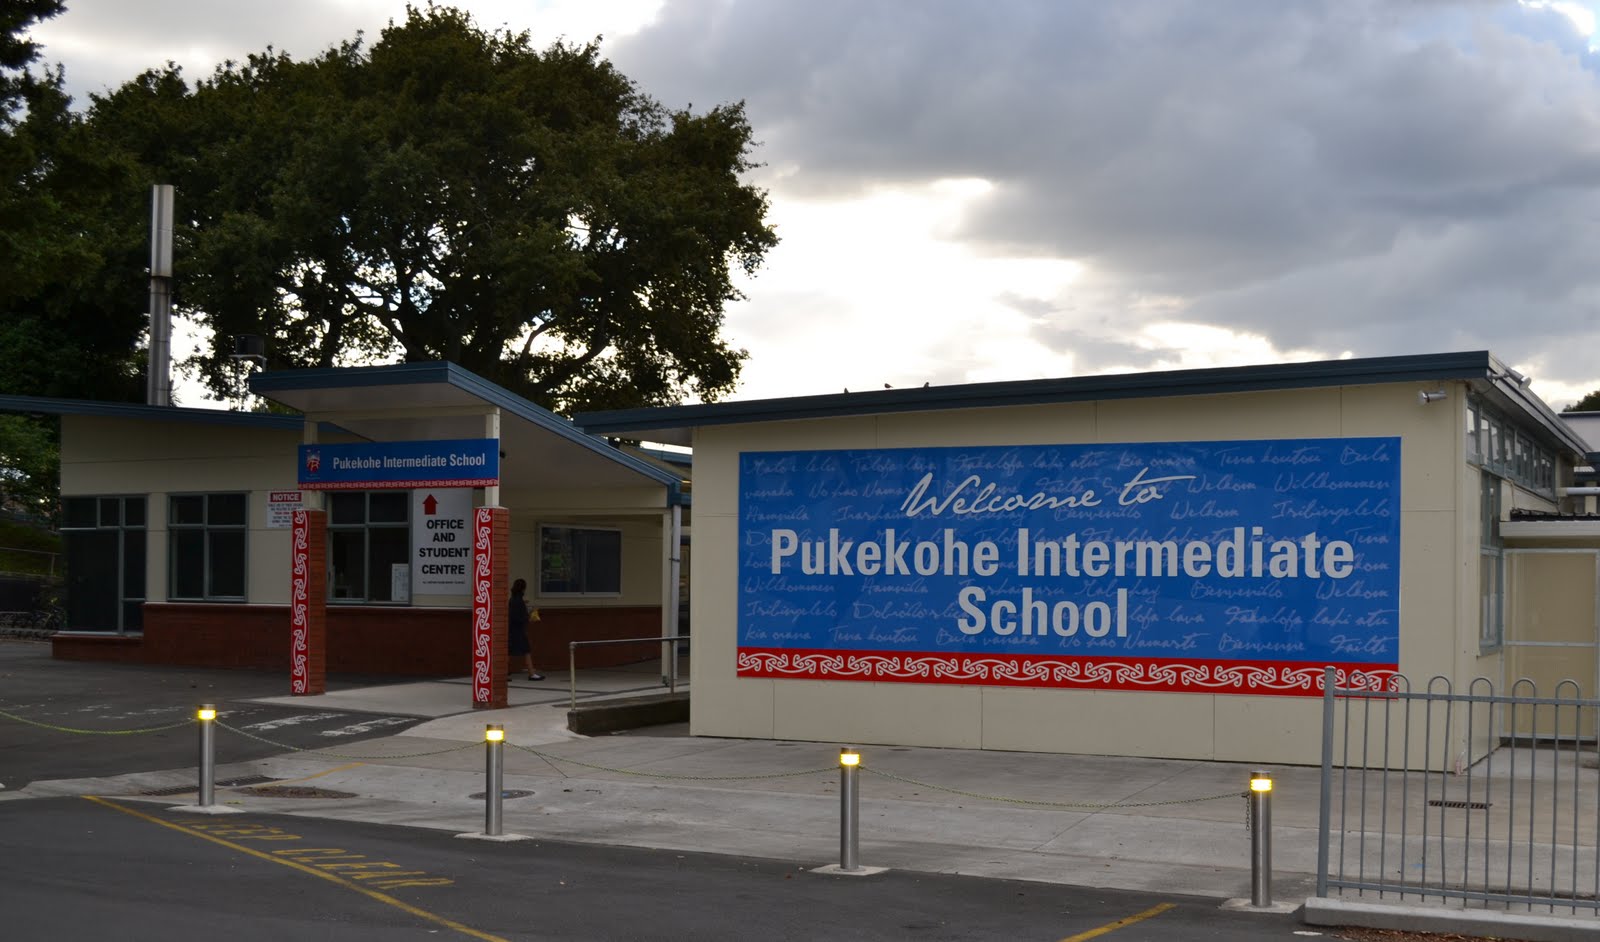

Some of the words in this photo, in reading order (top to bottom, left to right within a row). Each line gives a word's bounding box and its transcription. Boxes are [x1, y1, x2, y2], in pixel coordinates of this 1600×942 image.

[333, 456, 382, 471] Pukekohe
[383, 453, 448, 469] Intermediate
[449, 452, 486, 467] School
[272, 493, 300, 502] NOTICE
[900, 472, 1103, 517] Welcome
[1118, 466, 1197, 506] to
[426, 519, 465, 530] OFFICE
[432, 532, 456, 543] AND
[418, 547, 470, 558] STUDENT
[771, 527, 1000, 577] Pukekohe
[1018, 526, 1355, 580] Intermediate
[421, 564, 466, 575] CENTRE
[956, 585, 1129, 639] School
[271, 847, 456, 890] CLEAR
